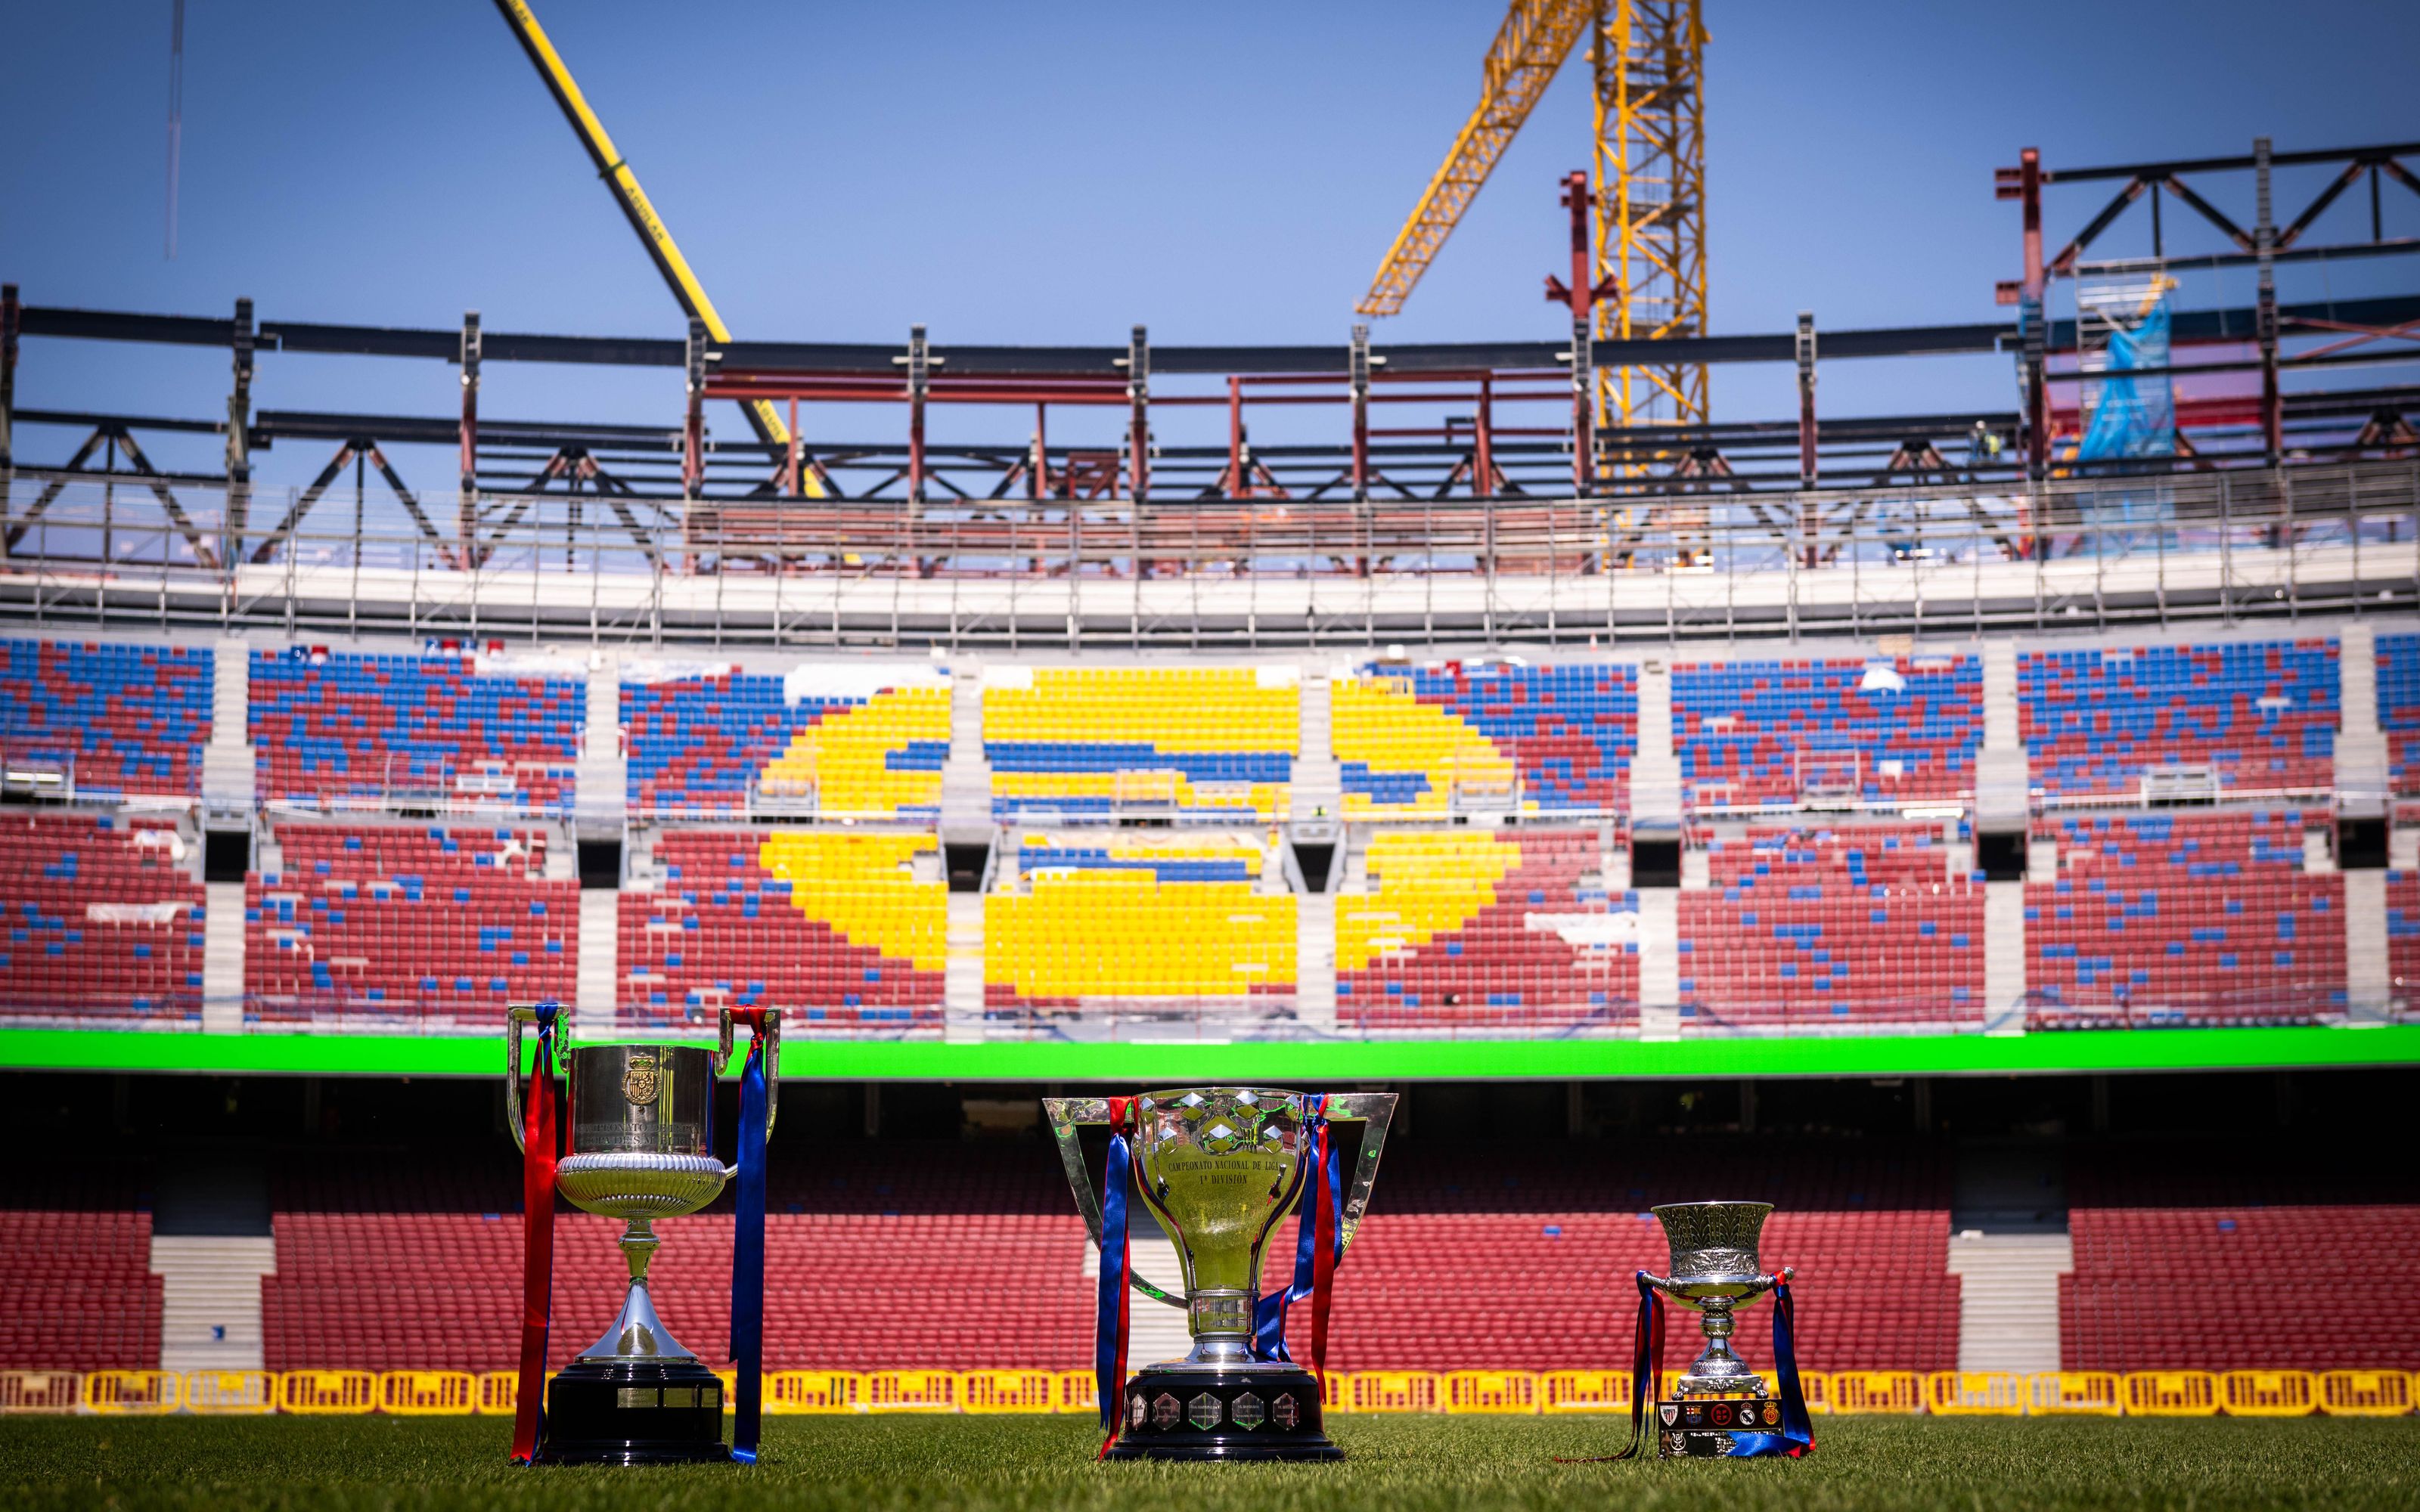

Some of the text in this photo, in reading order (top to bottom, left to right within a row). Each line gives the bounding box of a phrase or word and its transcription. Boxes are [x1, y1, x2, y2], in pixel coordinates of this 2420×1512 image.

[613, 1136, 631, 1145] DE
[1168, 1160, 1279, 1172] CAMPEONATO NACIONAL DE LIGA
[1211, 1172, 1247, 1185] DIVISIÓN
